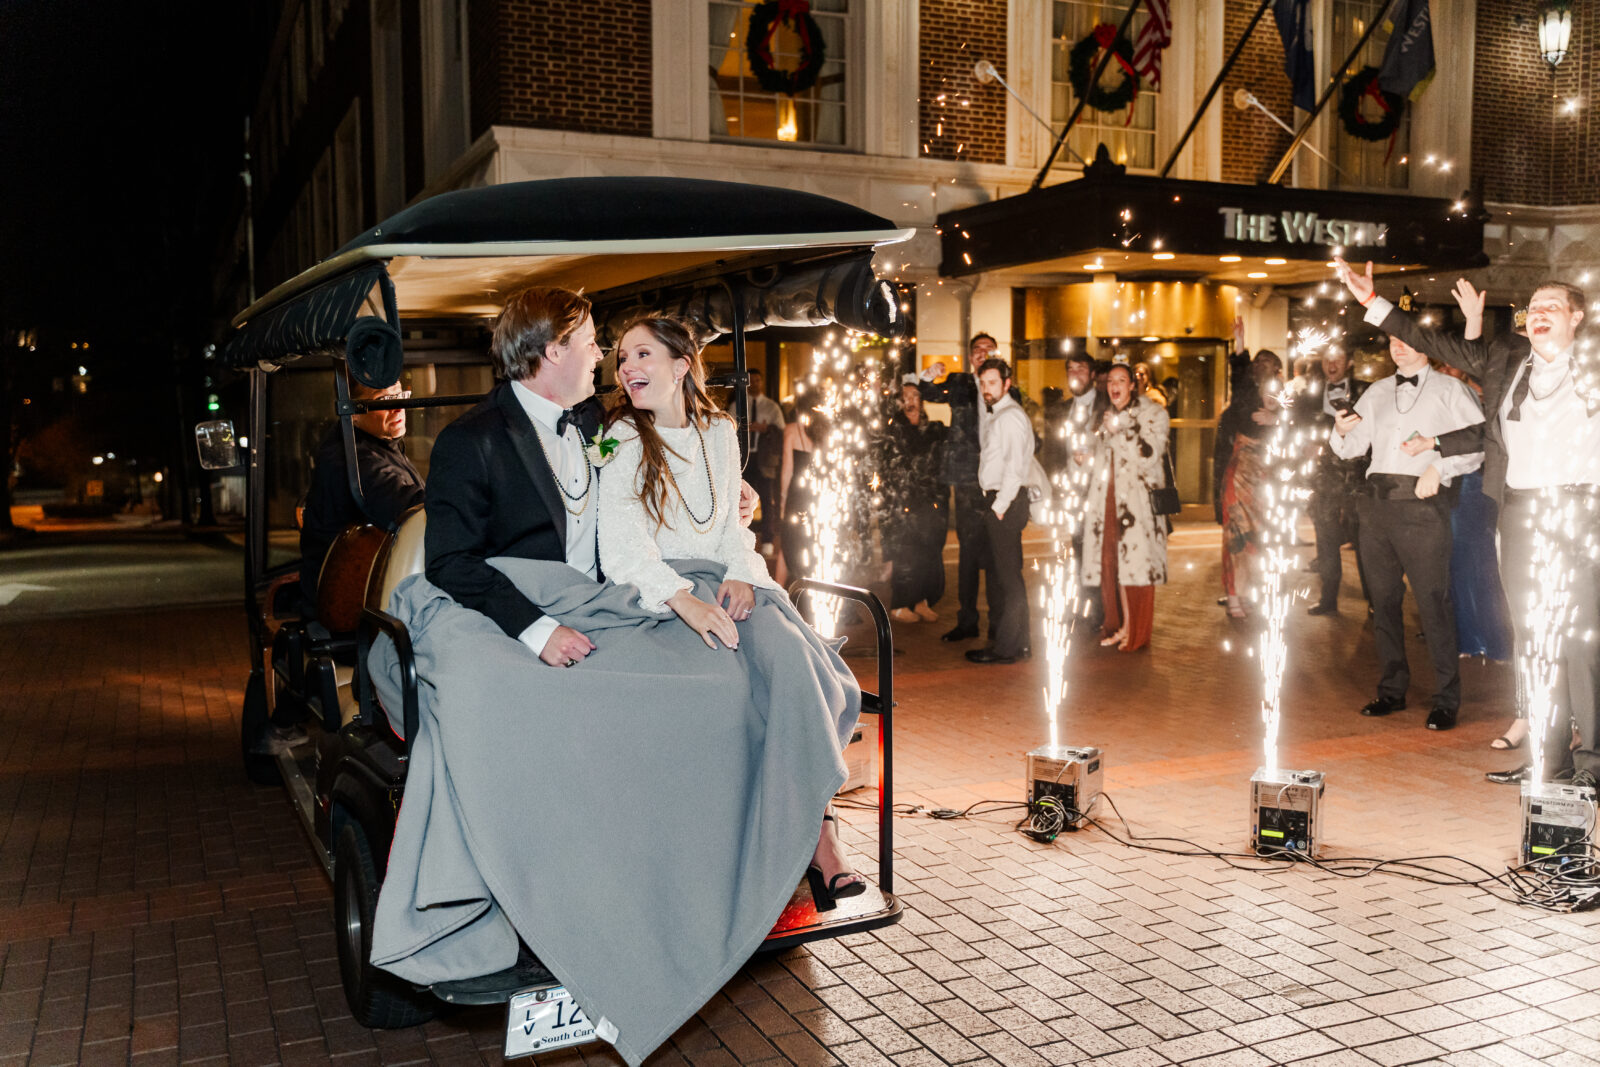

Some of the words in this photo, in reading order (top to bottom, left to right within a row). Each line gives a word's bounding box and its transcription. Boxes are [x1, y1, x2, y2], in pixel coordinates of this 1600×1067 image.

[1218, 207, 1277, 243] THE
[1281, 210, 1388, 247] WESTIN
[540, 1032, 570, 1045] South
